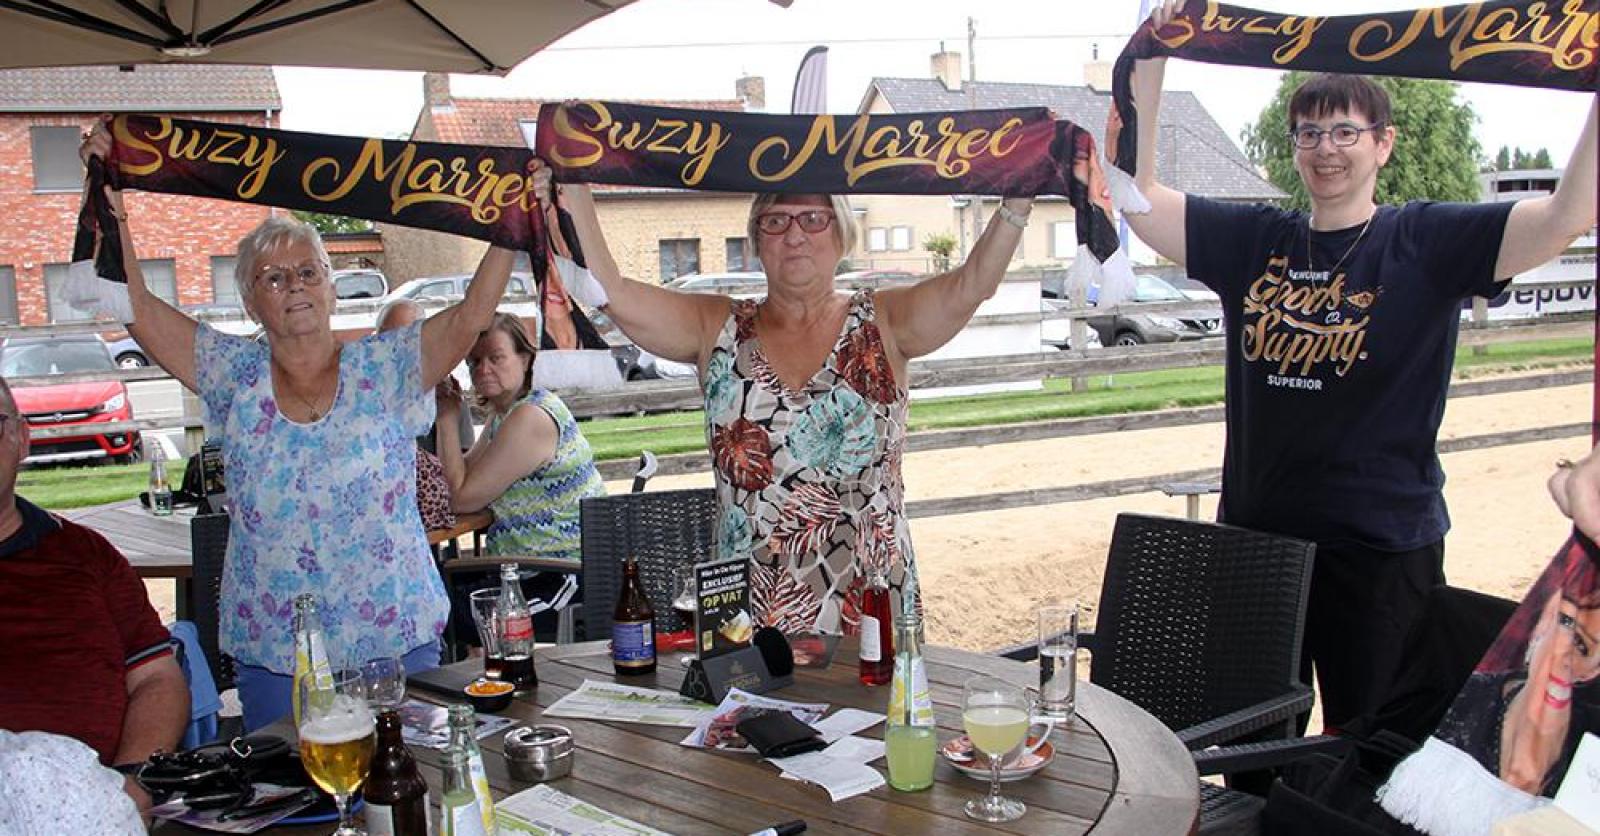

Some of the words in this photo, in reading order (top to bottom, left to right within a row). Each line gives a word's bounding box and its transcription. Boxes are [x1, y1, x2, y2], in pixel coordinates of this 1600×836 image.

[111, 113, 286, 200] Suzy
[551, 100, 731, 187] Suzy
[1267, 374, 1322, 391] SUPERIOR
[703, 595, 720, 608] OP
[721, 589, 743, 604] VAT
